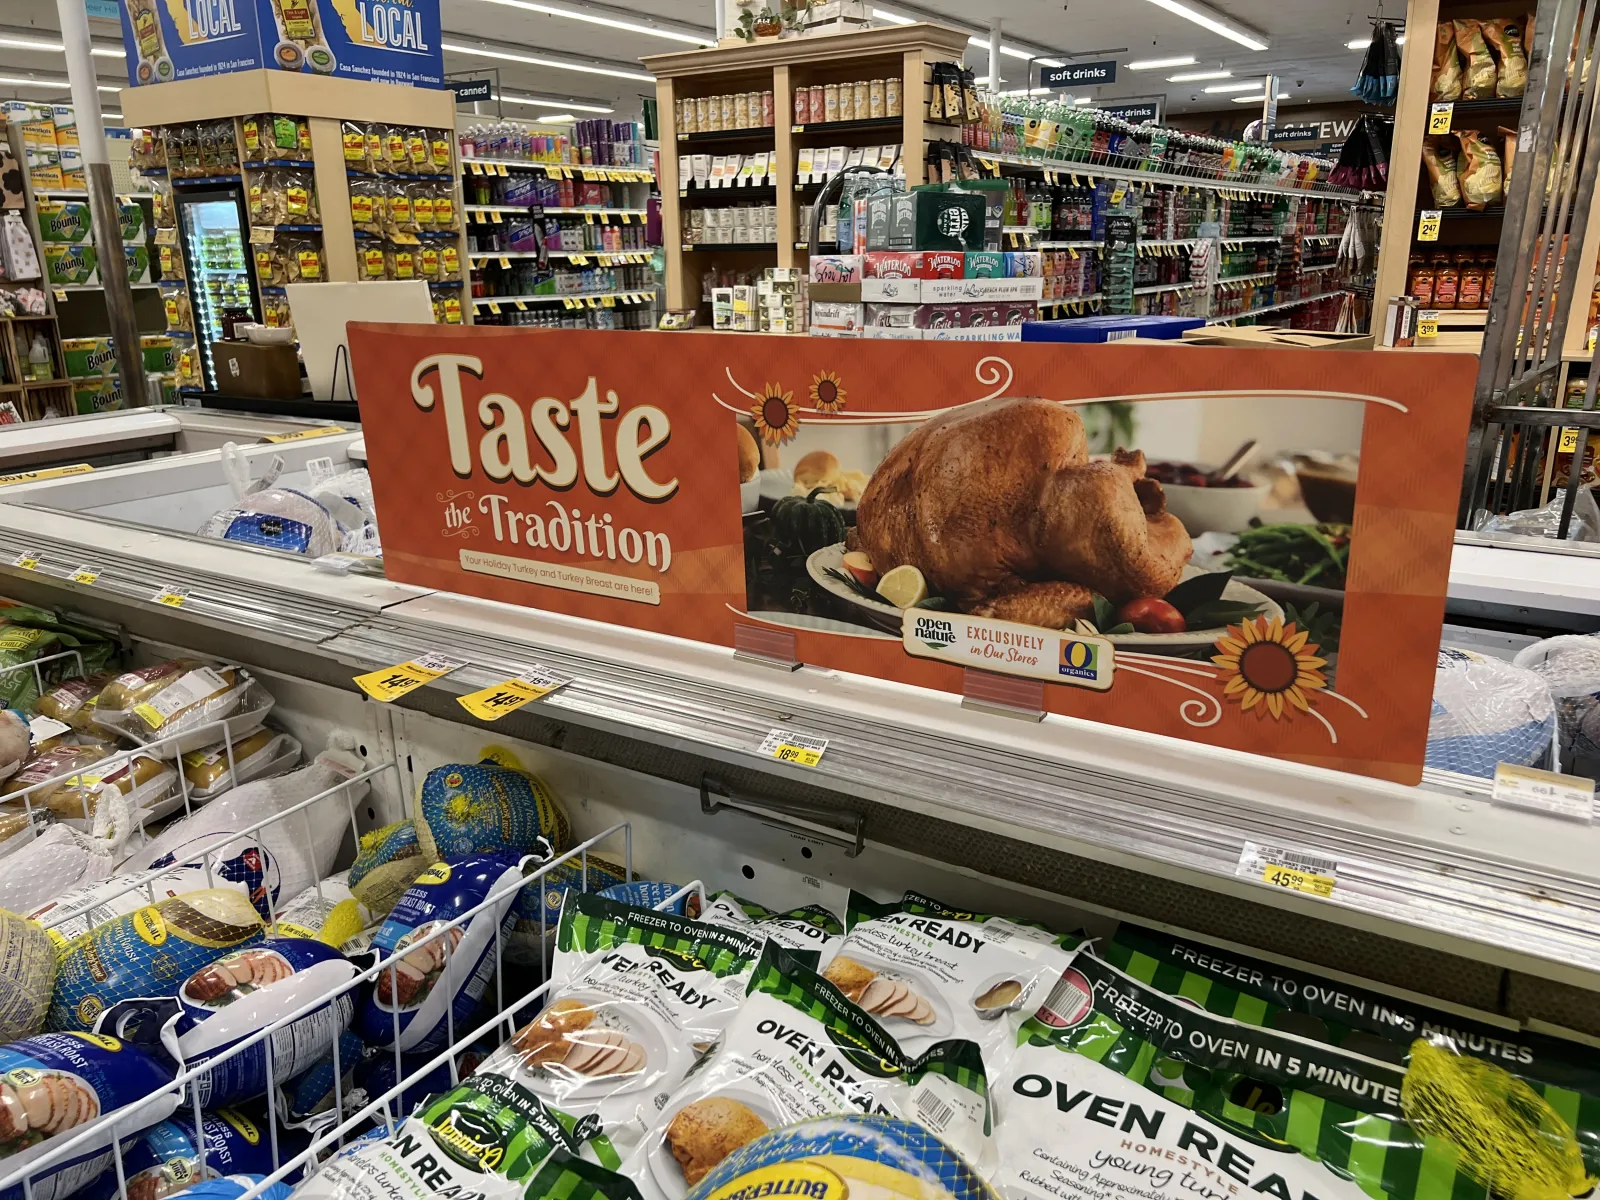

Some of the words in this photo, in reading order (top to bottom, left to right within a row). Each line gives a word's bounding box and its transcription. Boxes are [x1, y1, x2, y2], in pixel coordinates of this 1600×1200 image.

[186, 0, 242, 39] LOCAL
[360, 2, 428, 50] LOCAL
[340, 63, 351, 72] Casa
[352, 65, 370, 75] Sanchez
[371, 67, 390, 77] founded
[396, 70, 406, 79] 1924
[420, 74, 440, 84] Francisco
[1050, 70, 1071, 81] soft
[1072, 68, 1106, 79] drinks
[459, 85, 488, 96] canned
[1125, 108, 1151, 117] drinks
[1274, 131, 1288, 139] soft
[51, 215, 81, 232] Bounty
[54, 256, 85, 274] Bounty
[874, 257, 911, 278] WATERLOO
[928, 253, 961, 271] WATERLOO
[967, 254, 999, 272] WATERLOO
[815, 308, 840, 319] spindrift
[954, 333, 1004, 341] SPARKLING
[87, 348, 117, 371] Bount
[92, 388, 123, 410] Bount
[410, 353, 680, 503] Taste
[444, 502, 472, 529] the
[478, 494, 672, 573] Tradition
[464, 555, 482, 566] Your
[483, 557, 512, 573] Holiday
[513, 563, 538, 577] Turkey
[539, 568, 556, 579] and
[557, 571, 585, 586] Turkey
[586, 576, 613, 589] Breast
[614, 583, 629, 592] are
[630, 584, 653, 597] here!
[914, 627, 956, 644] nature
[917, 617, 952, 631] open
[967, 626, 1044, 650] EXCLUSIVELY
[970, 644, 982, 655] in
[983, 644, 1004, 659] Our
[1005, 648, 1038, 666] Stores
[1061, 667, 1095, 678] organics
[1271, 871, 1304, 886] 4599
[930, 902, 941, 911] TO
[628, 912, 667, 928] FREEZER
[669, 922, 682, 932] TO
[683, 926, 710, 939] OVEN
[708, 930, 718, 940] IN
[718, 933, 725, 941] 5
[725, 936, 761, 957] MINUTE
[881, 924, 934, 948] HOMESTYLE
[908, 919, 986, 954] READY
[854, 926, 887, 940] oneless
[888, 934, 923, 957] turkey
[924, 953, 959, 971] breast
[643, 961, 718, 1010] READY
[1171, 943, 1264, 987] FREEZER
[1271, 975, 1298, 996] TO
[1303, 985, 1365, 1016] OVEN
[1372, 1005, 1396, 1026] IN
[1400, 1015, 1416, 1032] 5
[1421, 1020, 1535, 1065] MINUTES
[814, 982, 849, 1017] FREEZER
[851, 1012, 864, 1027] TO
[864, 1023, 885, 1049] OVEN
[885, 1045, 896, 1059] IN
[1093, 979, 1163, 1032] FREEZER
[1163, 1019, 1183, 1039] TO
[1189, 1030, 1250, 1058] OVEN
[1255, 1047, 1281, 1070] IN
[1285, 1058, 1301, 1075] 5
[756, 1019, 826, 1067] OVEN
[60, 1045, 89, 1069] ROAST
[789, 1055, 846, 1111] HOMESTYLE
[517, 1097, 531, 1110] IN
[528, 1106, 539, 1116] 5
[1012, 1074, 1166, 1140] OVEN
[213, 1132, 233, 1165] ROAST
[1033, 1148, 1089, 1180] Containing
[1089, 1150, 1174, 1187] young
[1120, 1139, 1240, 1195] HOMESTYLE
[1019, 1169, 1058, 1195] Rubbed
